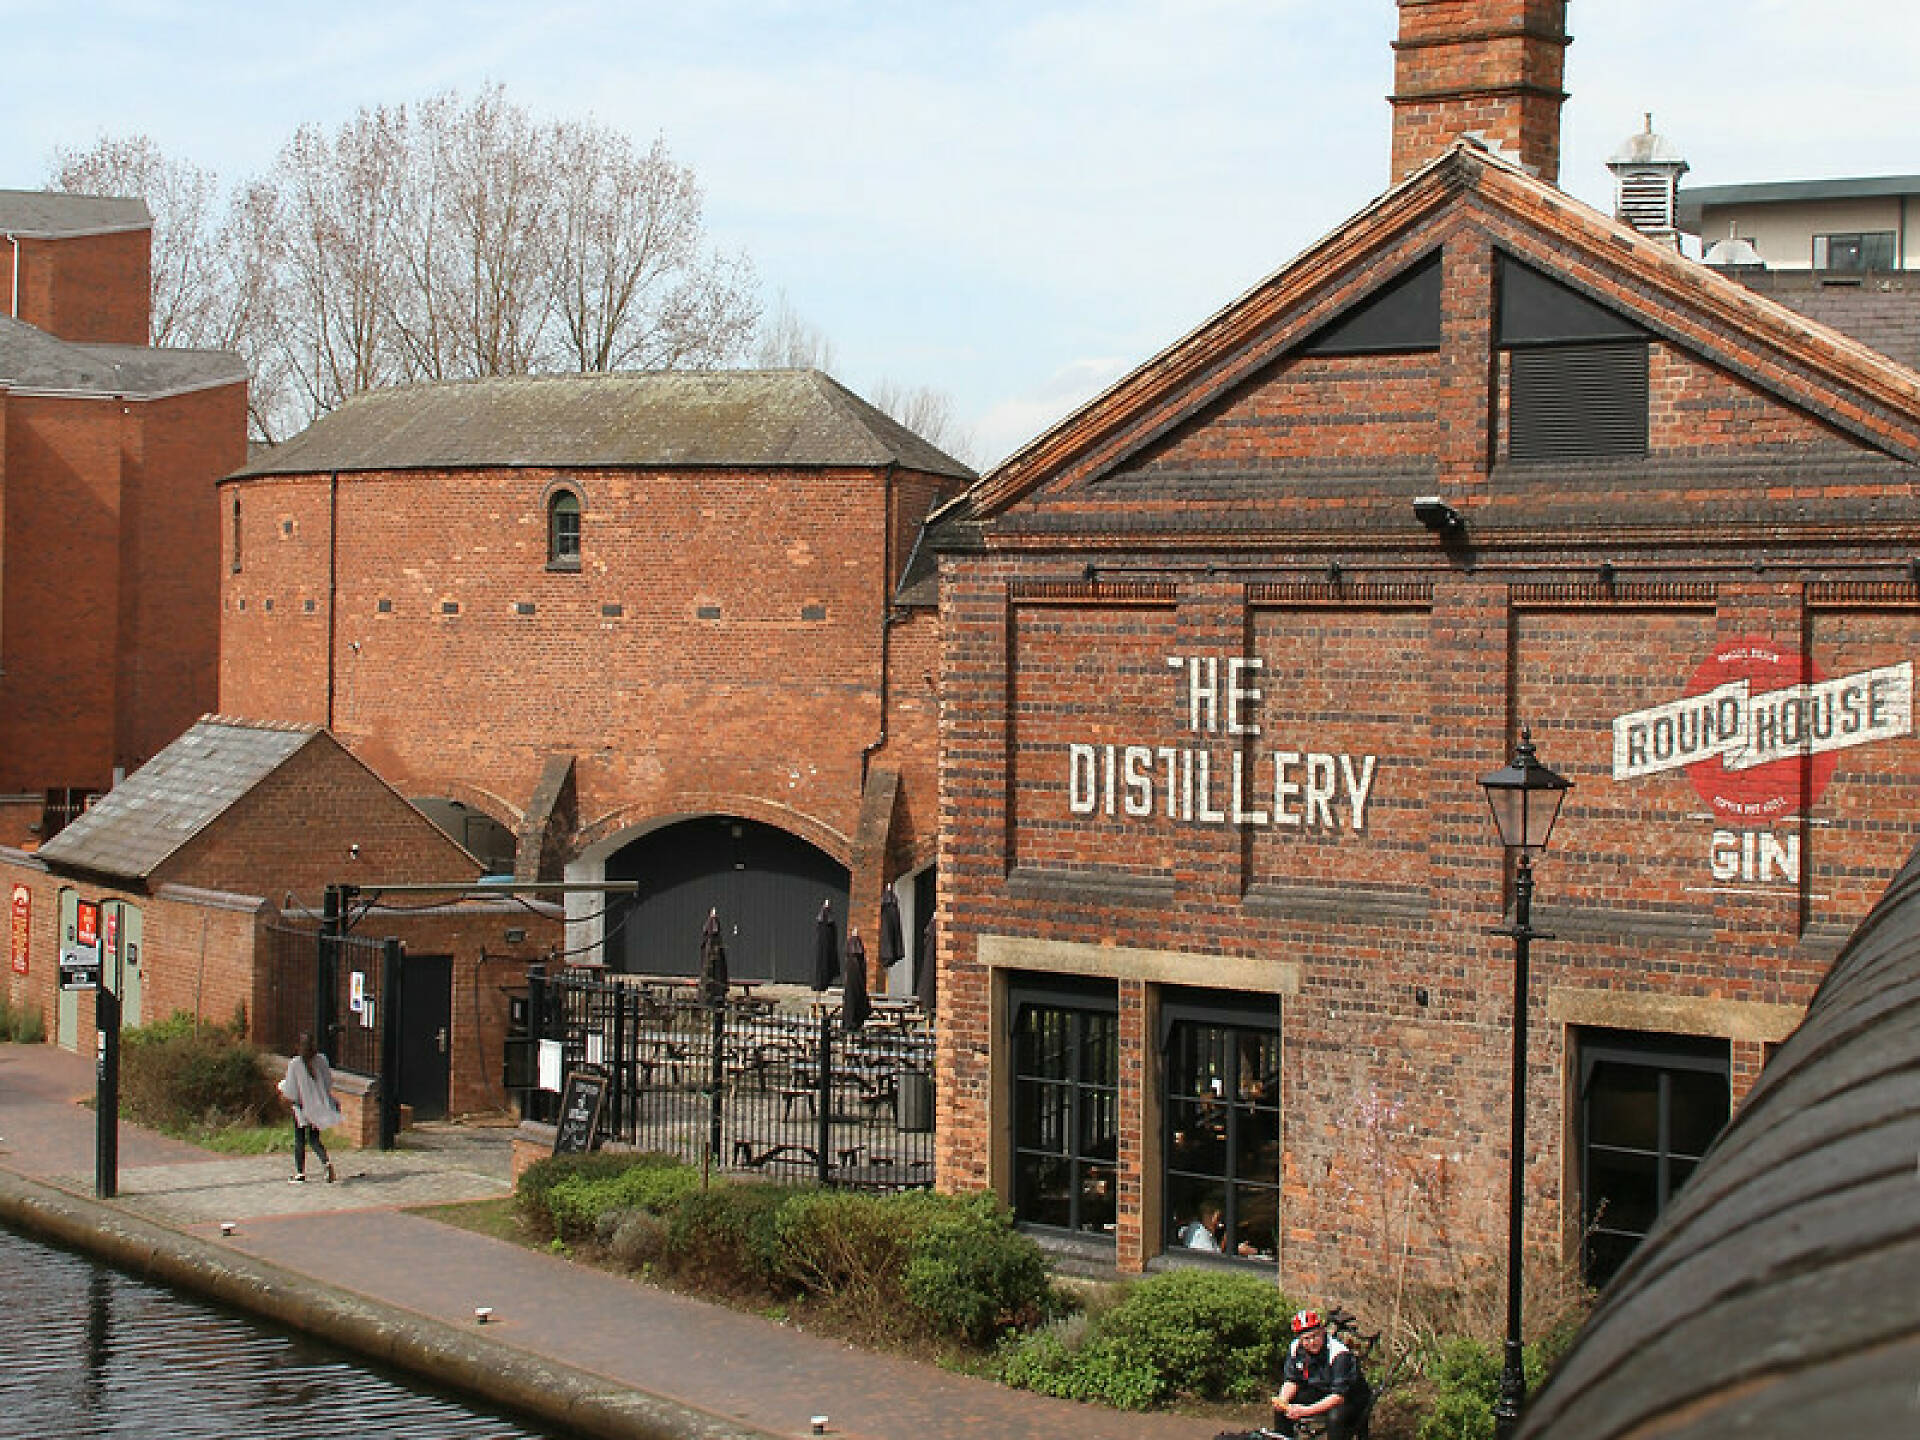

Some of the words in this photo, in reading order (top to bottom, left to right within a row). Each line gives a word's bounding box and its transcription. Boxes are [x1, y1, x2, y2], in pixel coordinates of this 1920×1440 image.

[1627, 695, 1739, 768] ROUND
[1757, 678, 1889, 753] HOUSE
[1070, 743, 1376, 829] DISTILLERY
[1711, 829, 1801, 883] GIN
